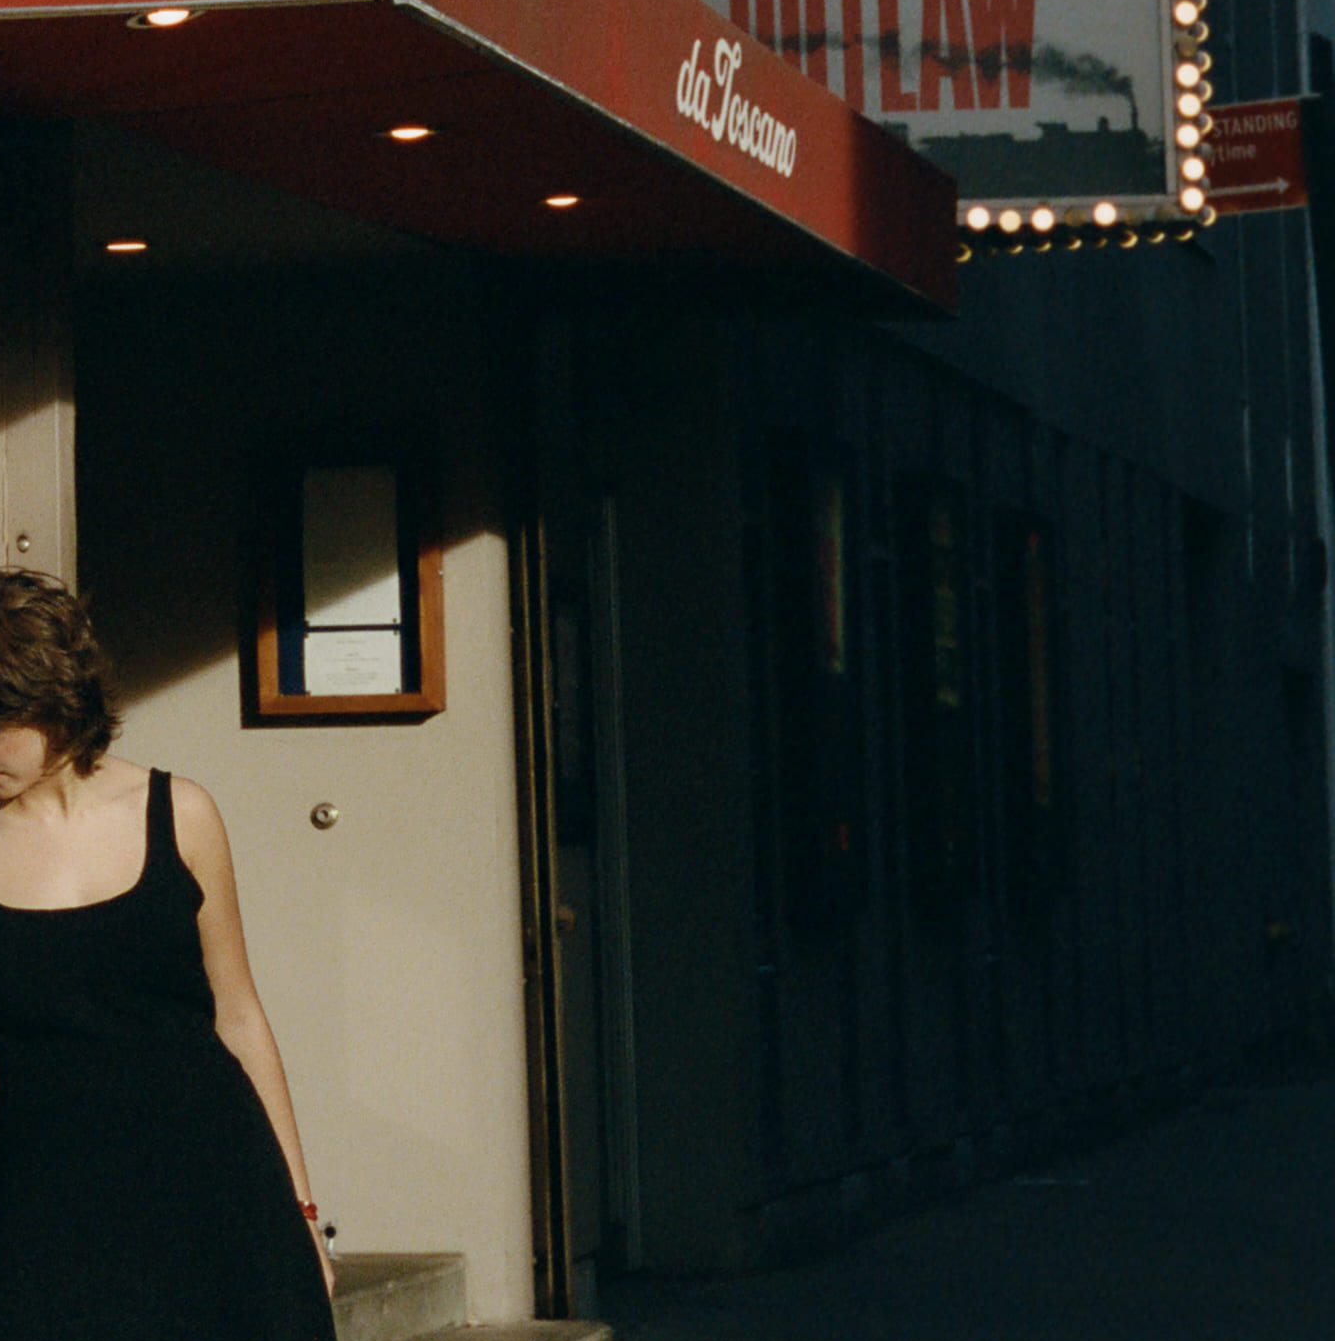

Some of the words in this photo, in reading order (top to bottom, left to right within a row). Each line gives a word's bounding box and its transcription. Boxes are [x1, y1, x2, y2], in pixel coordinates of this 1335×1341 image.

[677, 38, 711, 130] da
[711, 37, 797, 179] Toscano
[1213, 110, 1298, 139] STANDING
